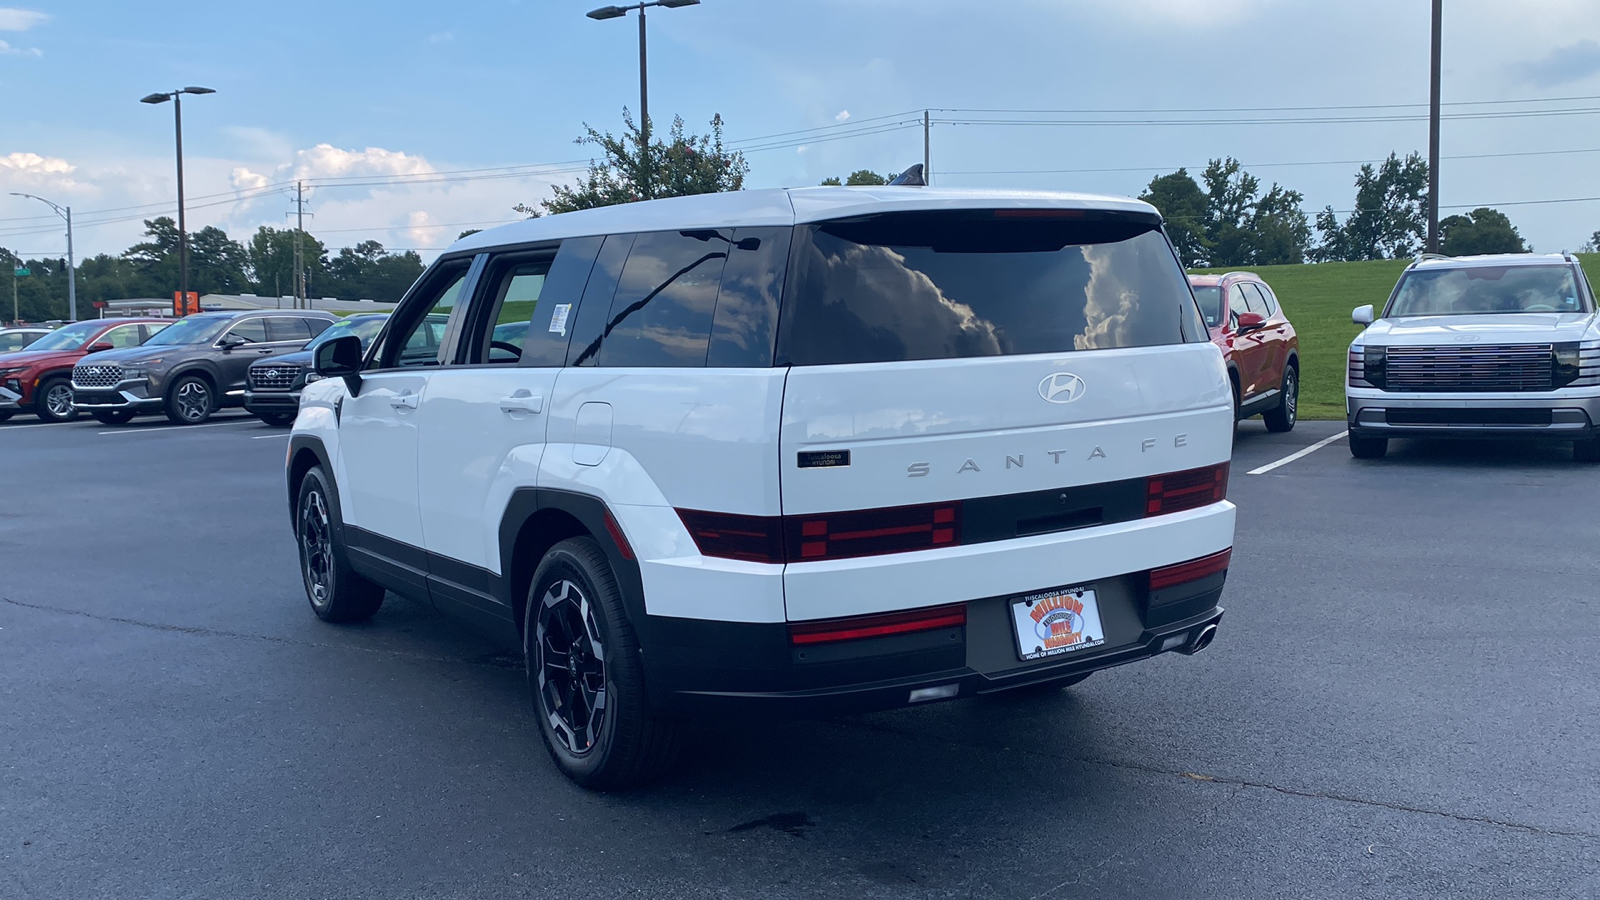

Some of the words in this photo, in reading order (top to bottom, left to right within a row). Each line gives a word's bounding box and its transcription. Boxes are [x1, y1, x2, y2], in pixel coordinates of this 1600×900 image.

[907, 445, 1107, 478] SANTA
[1141, 433, 1188, 453] FE
[1025, 591, 1060, 602] TUSCALOOSA
[1061, 587, 1084, 595] HYUNDAI
[1030, 596, 1084, 623] MILLION
[1051, 620, 1072, 635] MILE
[1026, 652, 1040, 660] HOME
[1047, 647, 1065, 656] MILLION
